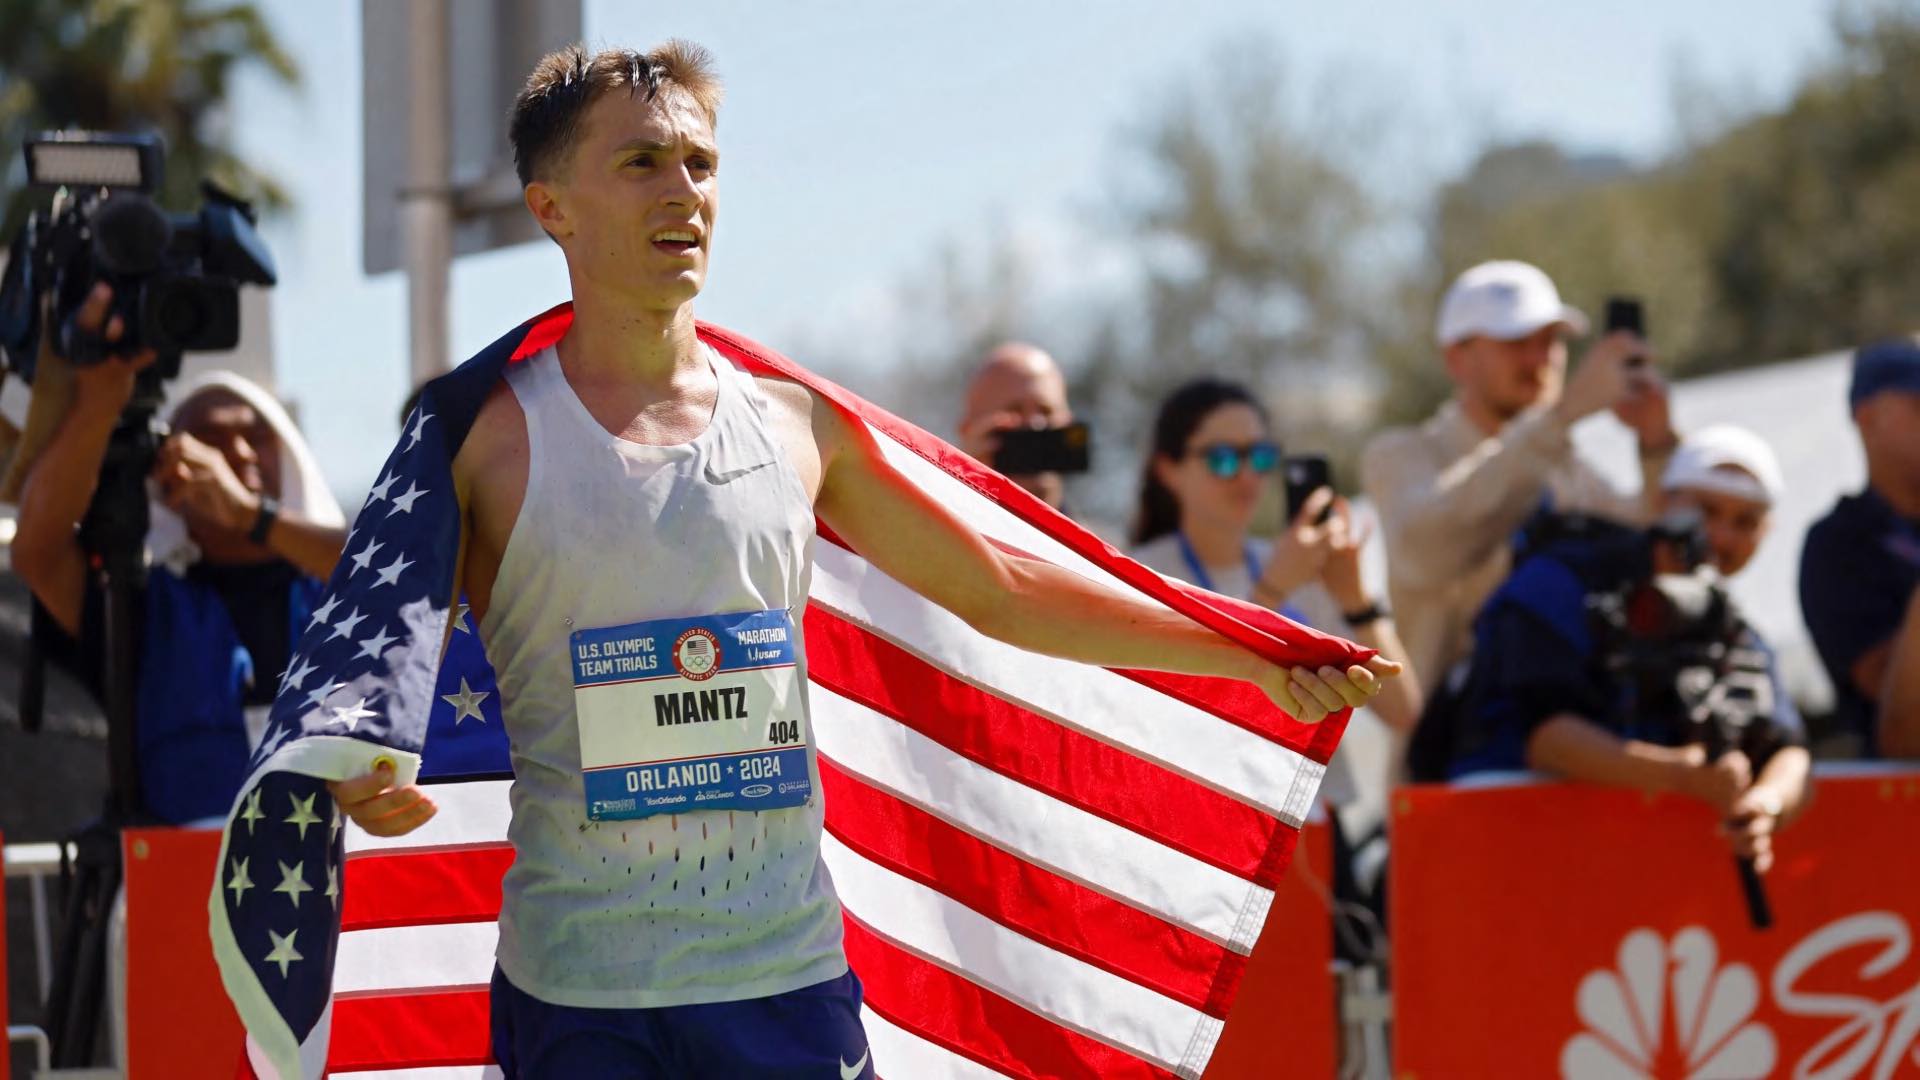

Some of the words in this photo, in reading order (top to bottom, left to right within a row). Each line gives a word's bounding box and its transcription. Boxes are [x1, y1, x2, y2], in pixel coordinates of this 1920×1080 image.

[738, 627, 787, 645] MARATHON
[578, 643, 602, 659] U.S.
[603, 637, 655, 657] OLYMPIC
[758, 649, 782, 660] USATF
[579, 659, 614, 677] TEAM
[615, 655, 657, 673] TRIALS
[654, 686, 748, 726] MANTZ
[769, 720, 799, 744] 404
[626, 762, 721, 793] ORLANDO
[740, 755, 781, 780] 2024
